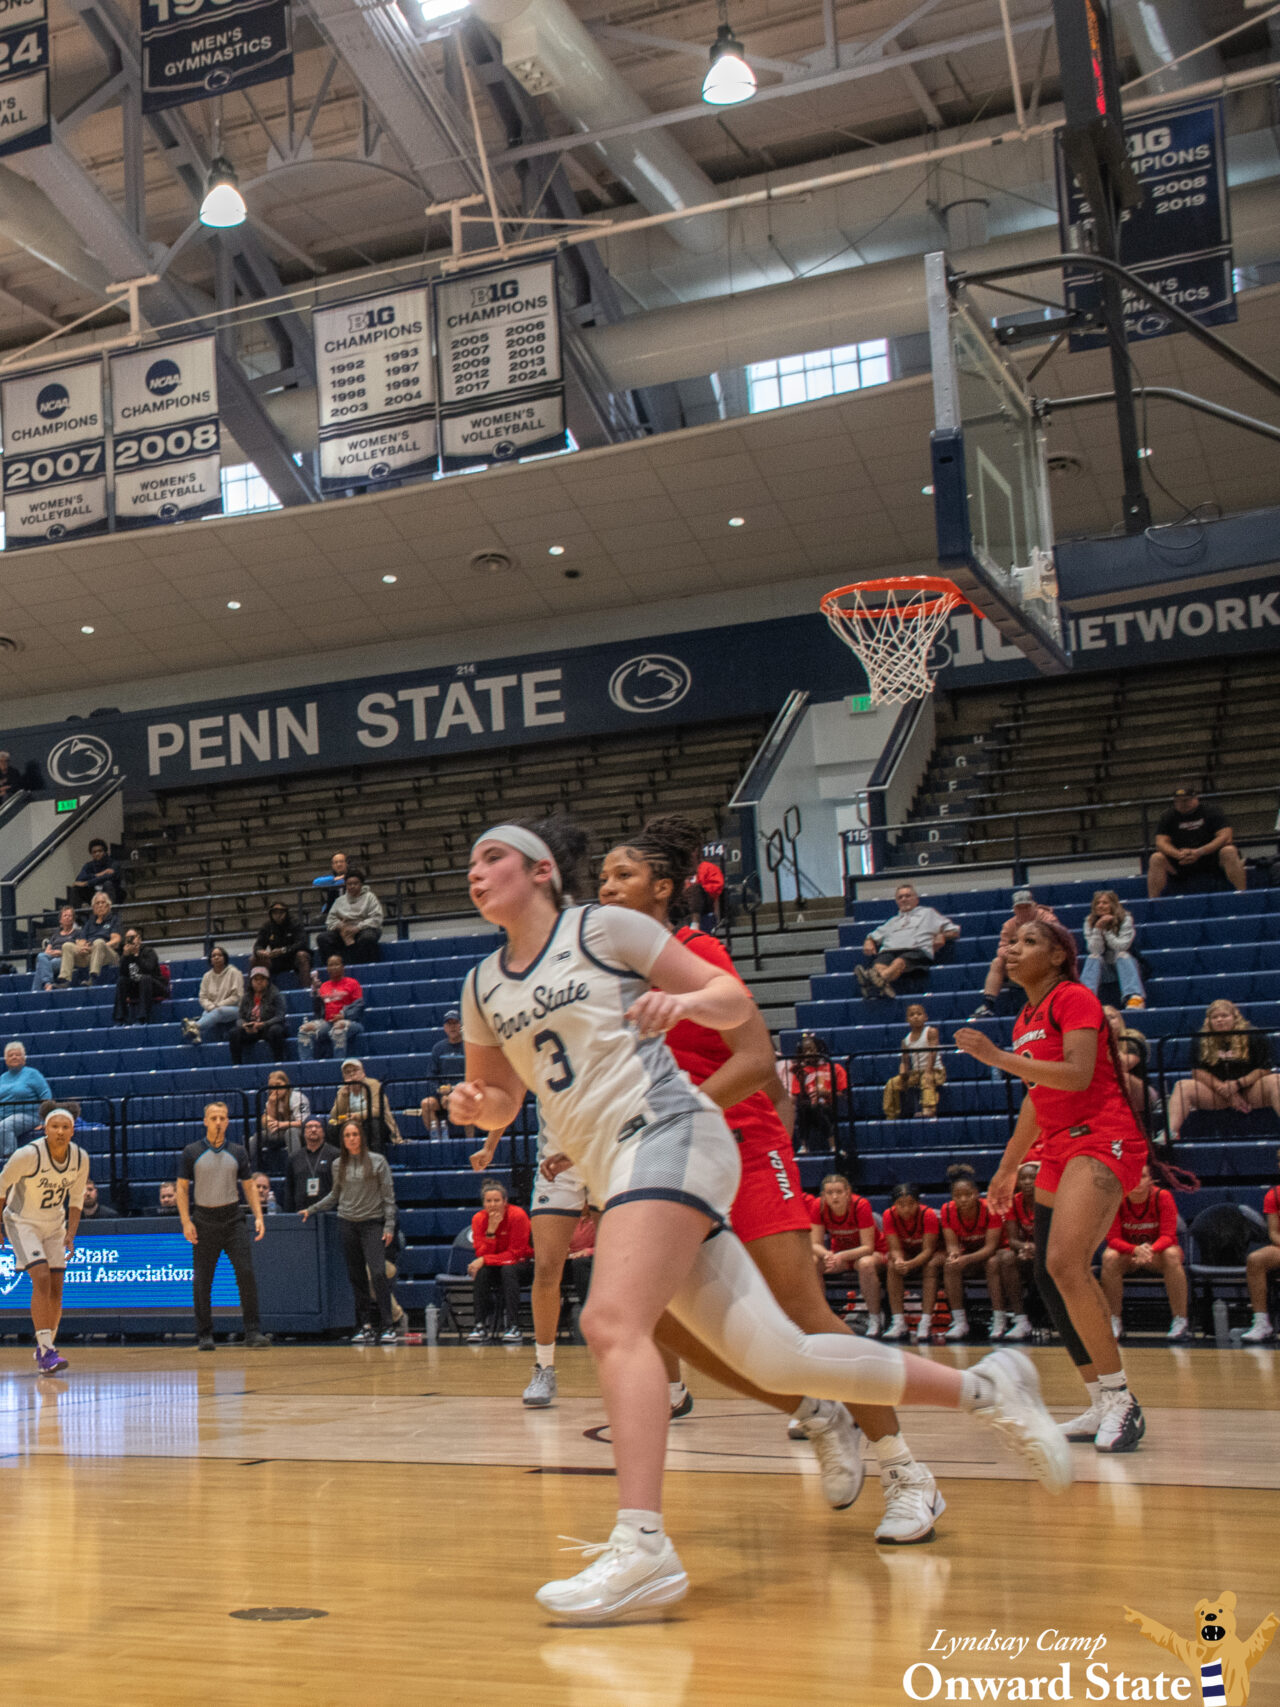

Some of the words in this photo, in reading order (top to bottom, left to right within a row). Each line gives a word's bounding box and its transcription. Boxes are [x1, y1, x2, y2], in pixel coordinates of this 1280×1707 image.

[191, 27, 243, 54] MEN'S
[164, 36, 272, 77] GYMNASTICS
[1152, 175, 1207, 197] 2008
[1155, 193, 1207, 214] 2019
[447, 295, 548, 328] CHAMPIONS
[324, 321, 423, 353] CHAMPIONS
[451, 332, 489, 349] 2005
[505, 321, 545, 338] 2006
[451, 344, 490, 361] 2007
[505, 332, 546, 349] 2008
[329, 360, 366, 376] 1992
[384, 347, 420, 363] 1993
[452, 356, 491, 373] 2009
[508, 344, 545, 361] 2010
[454, 369, 489, 384] 2012
[509, 356, 546, 372] 2013
[149, 372, 182, 389] NCAA
[330, 374, 366, 389] 1996
[385, 362, 420, 377] 1997
[455, 380, 490, 396] 2017
[508, 368, 548, 385] 2024
[331, 388, 367, 404] 1998
[385, 377, 421, 392] 1999
[39, 395, 70, 413] NCAA
[121, 390, 211, 420] CHAMPIONS
[330, 402, 369, 418] 2003
[384, 391, 423, 407] 2004
[11, 414, 98, 442] CHAMPIONS
[470, 408, 535, 429] WOMEN'S
[347, 430, 409, 452] WOMEN'S
[462, 419, 545, 445] VOLLEYBALL
[116, 424, 218, 468] 2008
[338, 441, 421, 466] VOLLEYBALL
[7, 446, 103, 488] 2007
[131, 483, 207, 505] VOLLEYBALL
[139, 472, 197, 492] WOMEN'S
[20, 504, 92, 526] VOLLEYBALL
[29, 494, 84, 513] WOMEN'S
[456, 664, 476, 675] 214
[147, 701, 319, 776] PENN
[356, 669, 565, 748] STATE
[846, 830, 870, 842] 115
[928, 830, 939, 842] D
[703, 844, 725, 857] 114
[731, 849, 741, 862] D
[918, 853, 929, 866] C
[493, 1012, 531, 1040] Penn
[532, 980, 590, 1020] State
[533, 1028, 575, 1093] 3
[40, 1187, 65, 1209] 23
[95, 1264, 195, 1283] Association
